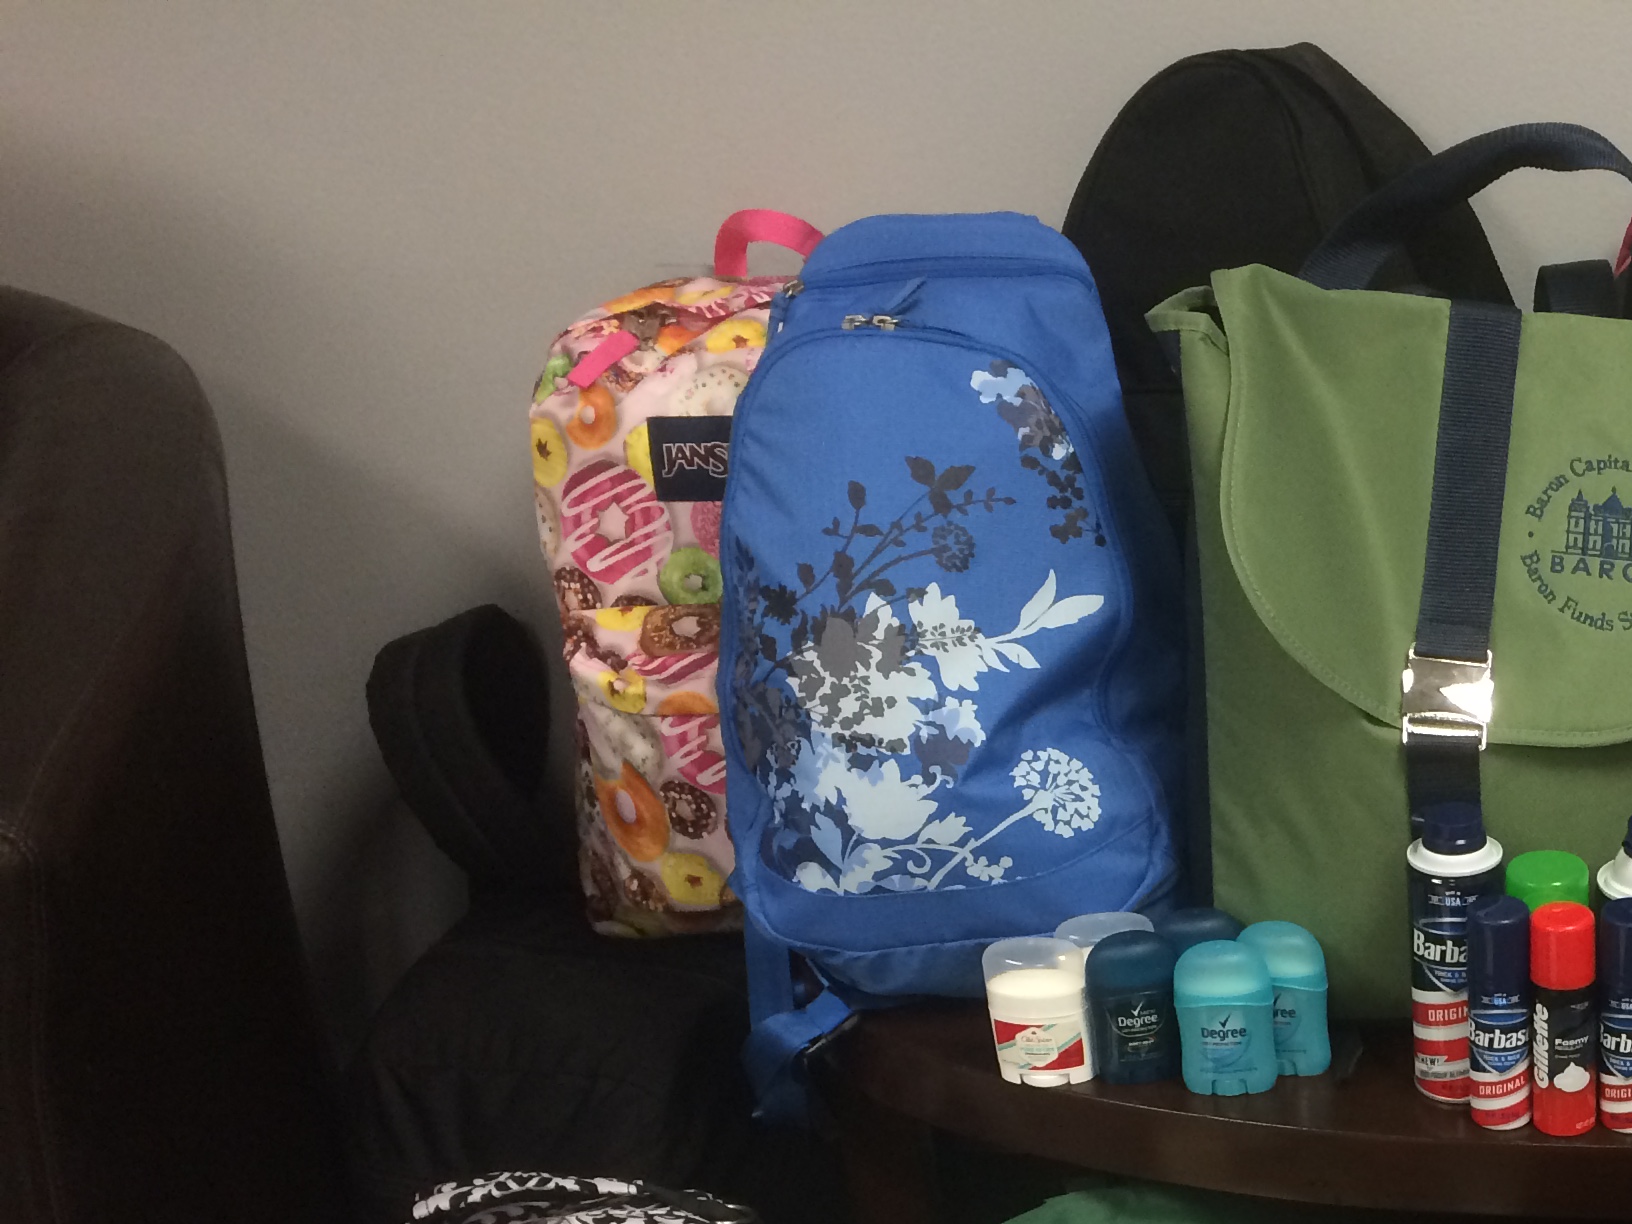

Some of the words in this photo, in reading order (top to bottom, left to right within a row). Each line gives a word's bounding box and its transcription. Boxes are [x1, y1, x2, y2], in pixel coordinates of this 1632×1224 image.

[661, 442, 729, 478] JANS
[1526, 472, 1570, 521] Baron
[1519, 549, 1558, 605] Baron
[1557, 596, 1615, 633] Funds
[1445, 896, 1462, 907] USA
[1413, 927, 1468, 964] Barba
[1117, 1013, 1159, 1028] Degree
[1428, 1005, 1469, 1022] ORIGIN
[1200, 1026, 1247, 1042] Degree
[1469, 1019, 1529, 1049] Barbas
[1533, 1002, 1549, 1089] Gillette
[1479, 1076, 1526, 1096] ORIGINAL
